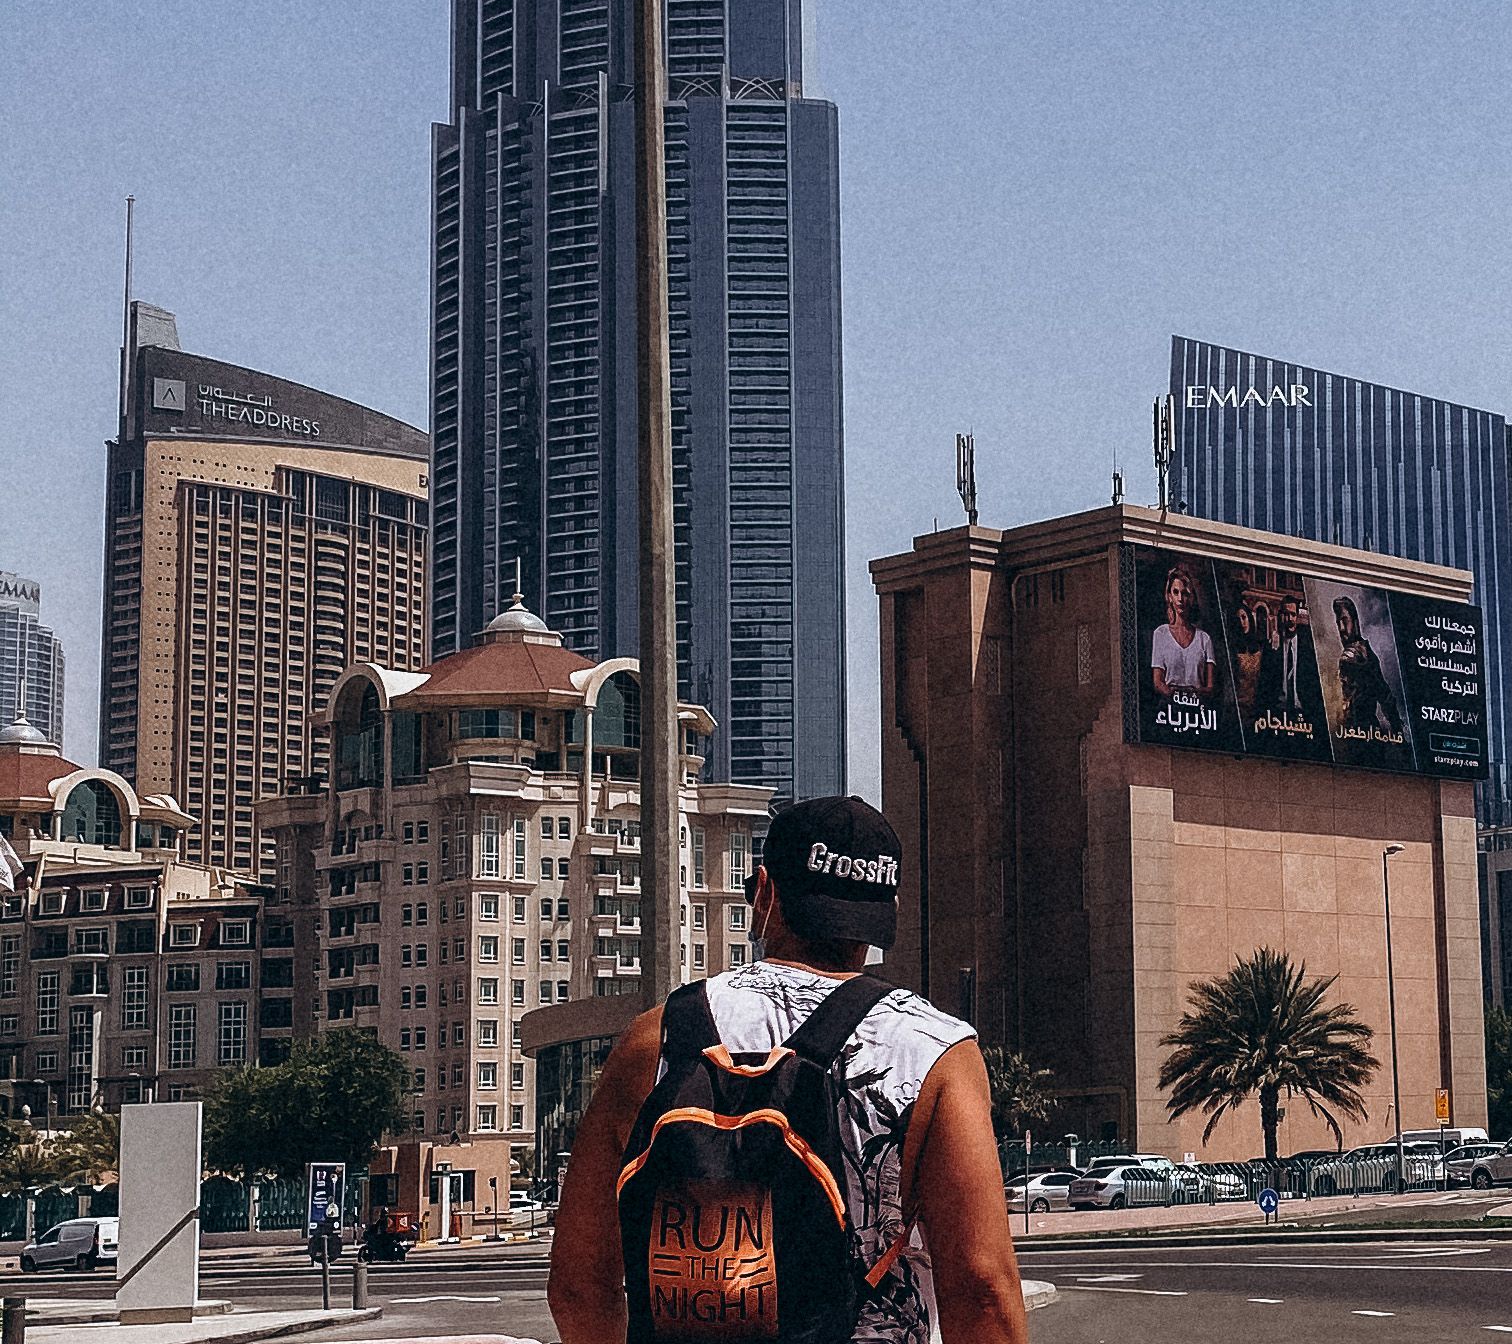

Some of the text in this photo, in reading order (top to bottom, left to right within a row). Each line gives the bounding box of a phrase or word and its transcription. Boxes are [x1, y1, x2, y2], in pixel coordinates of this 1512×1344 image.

[1185, 384, 1313, 409] EMAAR
[1417, 655, 1478, 676] المسلسلات
[1173, 690, 1200, 707] شقة
[1441, 676, 1479, 697] التركية
[1155, 703, 1217, 735] الأبرياء
[1421, 705, 1479, 726] STARZPLAY
[806, 842, 899, 886] CrossFit
[659, 1199, 764, 1253] RUN
[685, 1255, 737, 1281] THE
[655, 1280, 775, 1324] NIGHT
